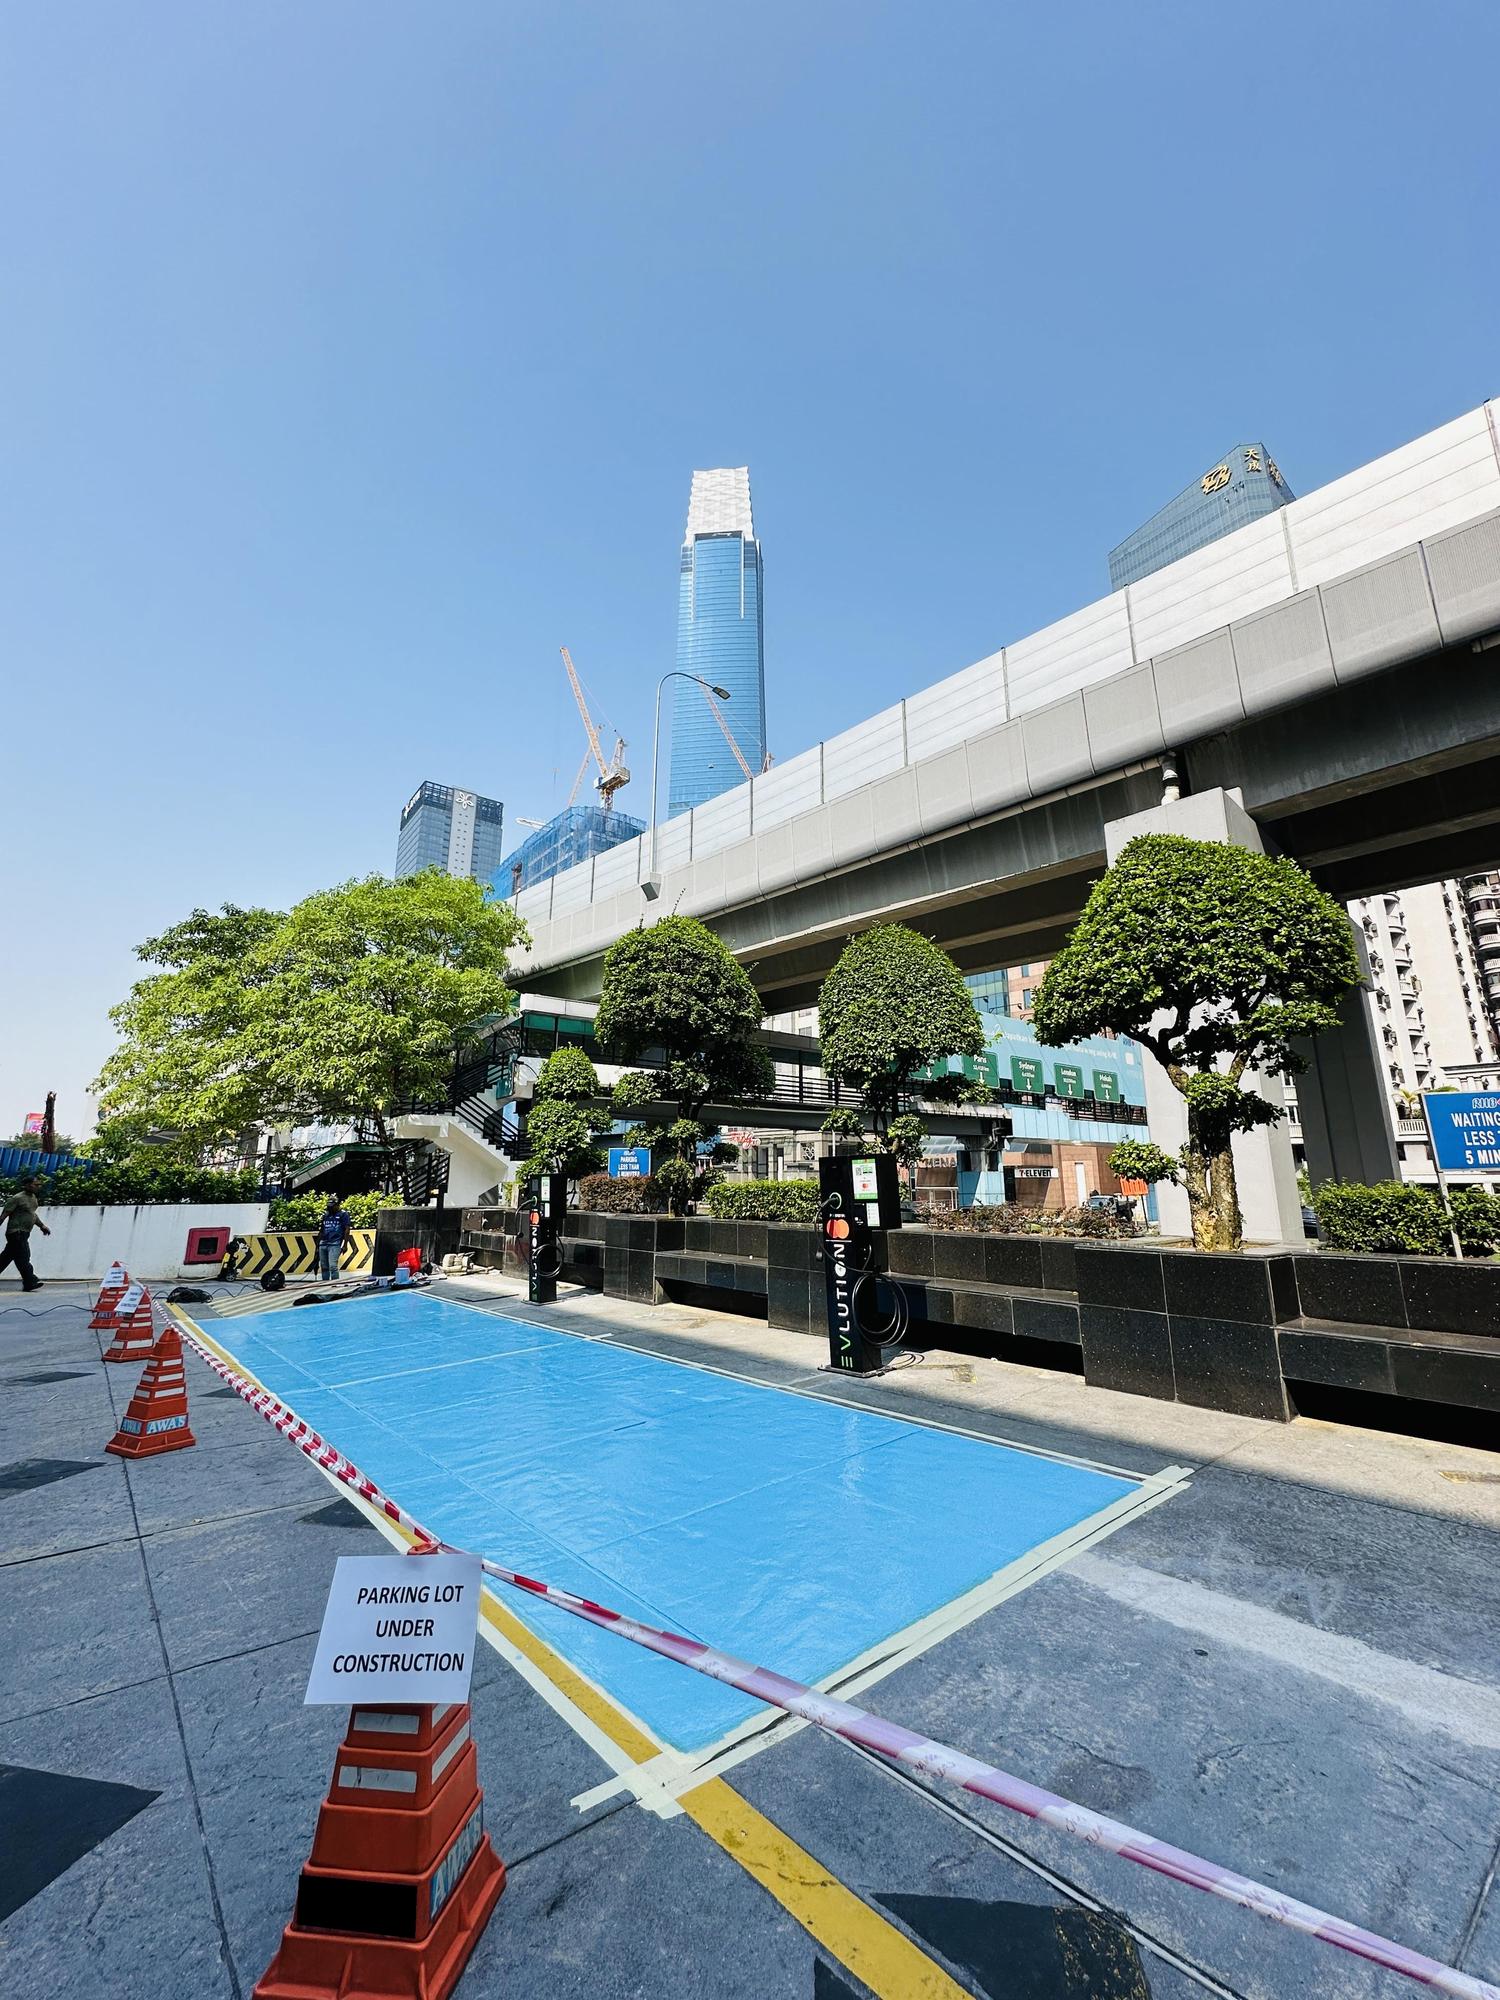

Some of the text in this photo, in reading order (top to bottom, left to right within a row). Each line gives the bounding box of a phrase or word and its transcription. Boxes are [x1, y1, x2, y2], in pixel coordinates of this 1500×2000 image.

[1018, 1061, 1036, 1072] Sydney
[1463, 1131, 1496, 1146] LESS
[1465, 1150, 1474, 1165] 5
[146, 1416, 185, 1434] AWAS
[357, 1585, 464, 1604] PARKING LOT
[376, 1619, 434, 1637] UNDER
[333, 1653, 464, 1673] CONSTRUCTION
